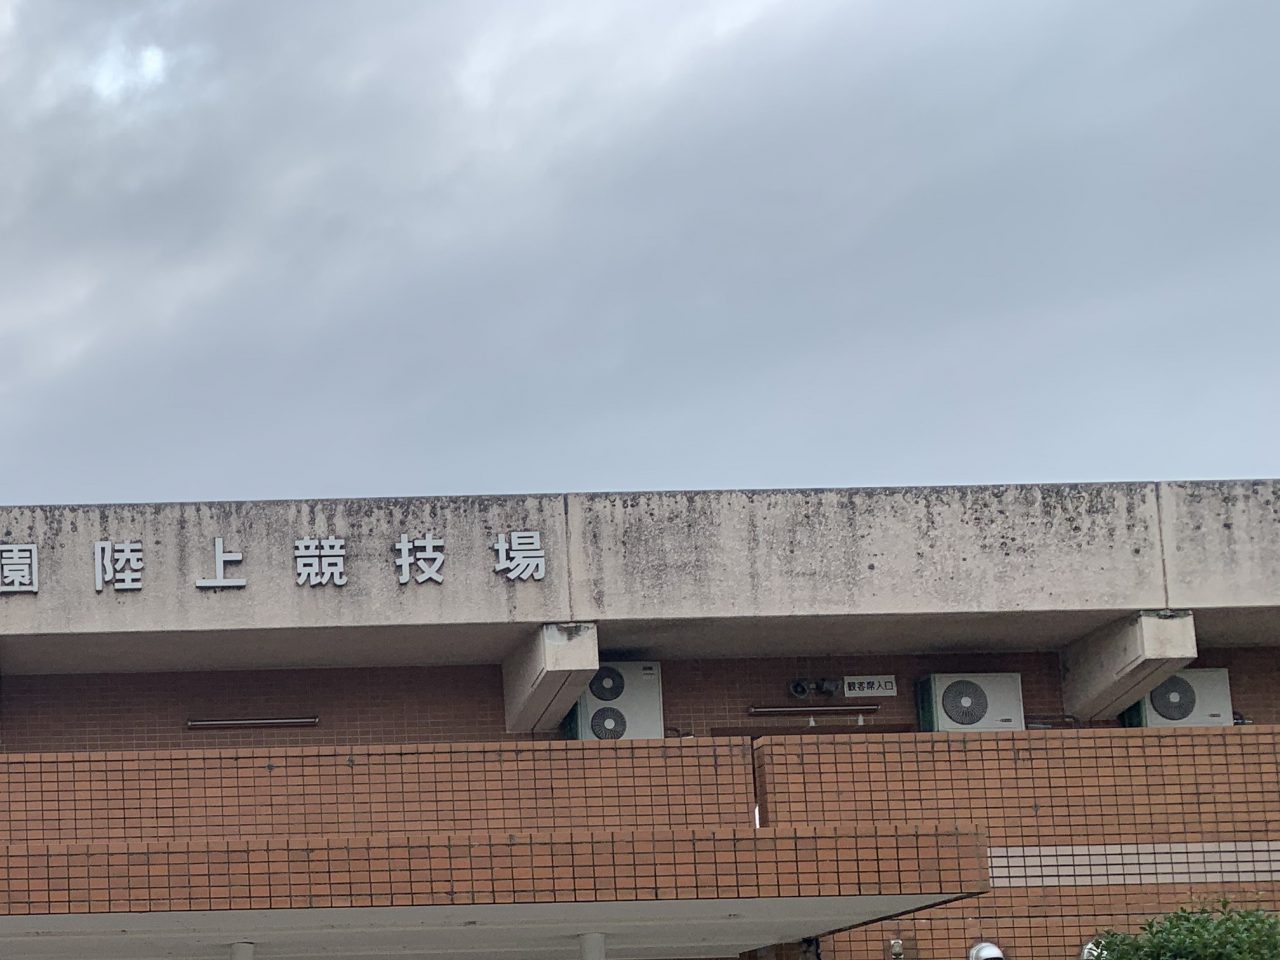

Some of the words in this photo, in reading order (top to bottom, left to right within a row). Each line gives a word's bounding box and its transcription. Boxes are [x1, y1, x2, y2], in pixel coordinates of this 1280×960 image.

[847, 680, 894, 692] 観客席入口
